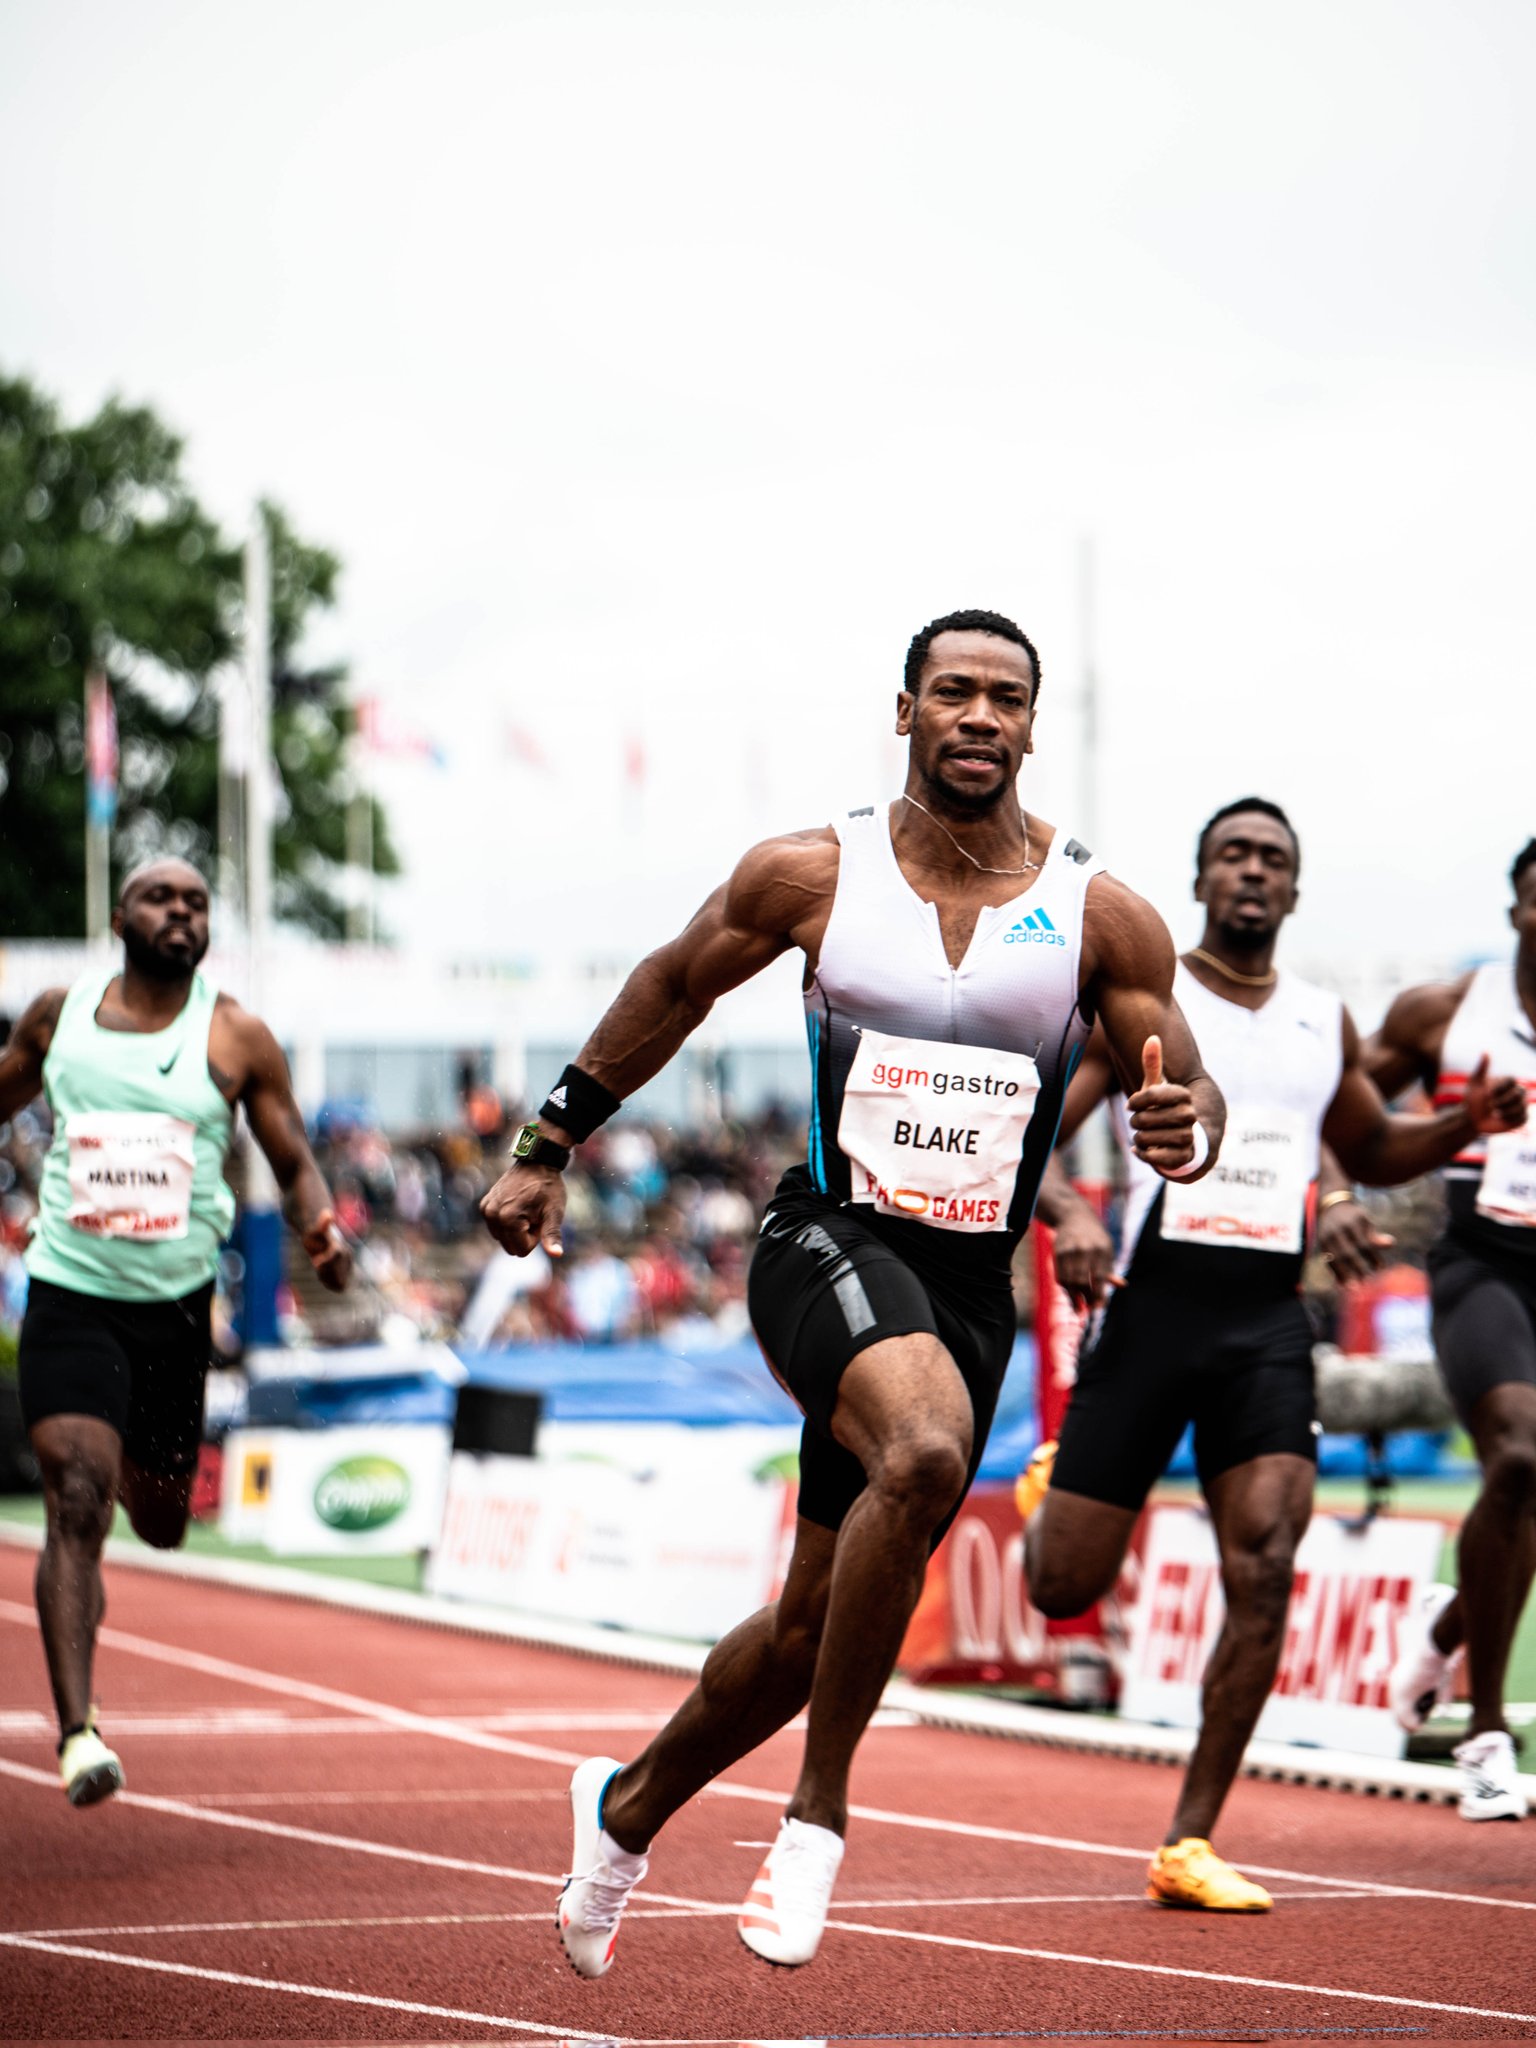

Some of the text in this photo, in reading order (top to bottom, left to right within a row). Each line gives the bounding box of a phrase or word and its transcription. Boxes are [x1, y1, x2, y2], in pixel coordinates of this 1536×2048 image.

[1003, 930, 1066, 946] adidas
[893, 1120, 981, 1155] BLAKE
[87, 1169, 169, 1187] MARTINA
[932, 1196, 1000, 1223] GAMES
